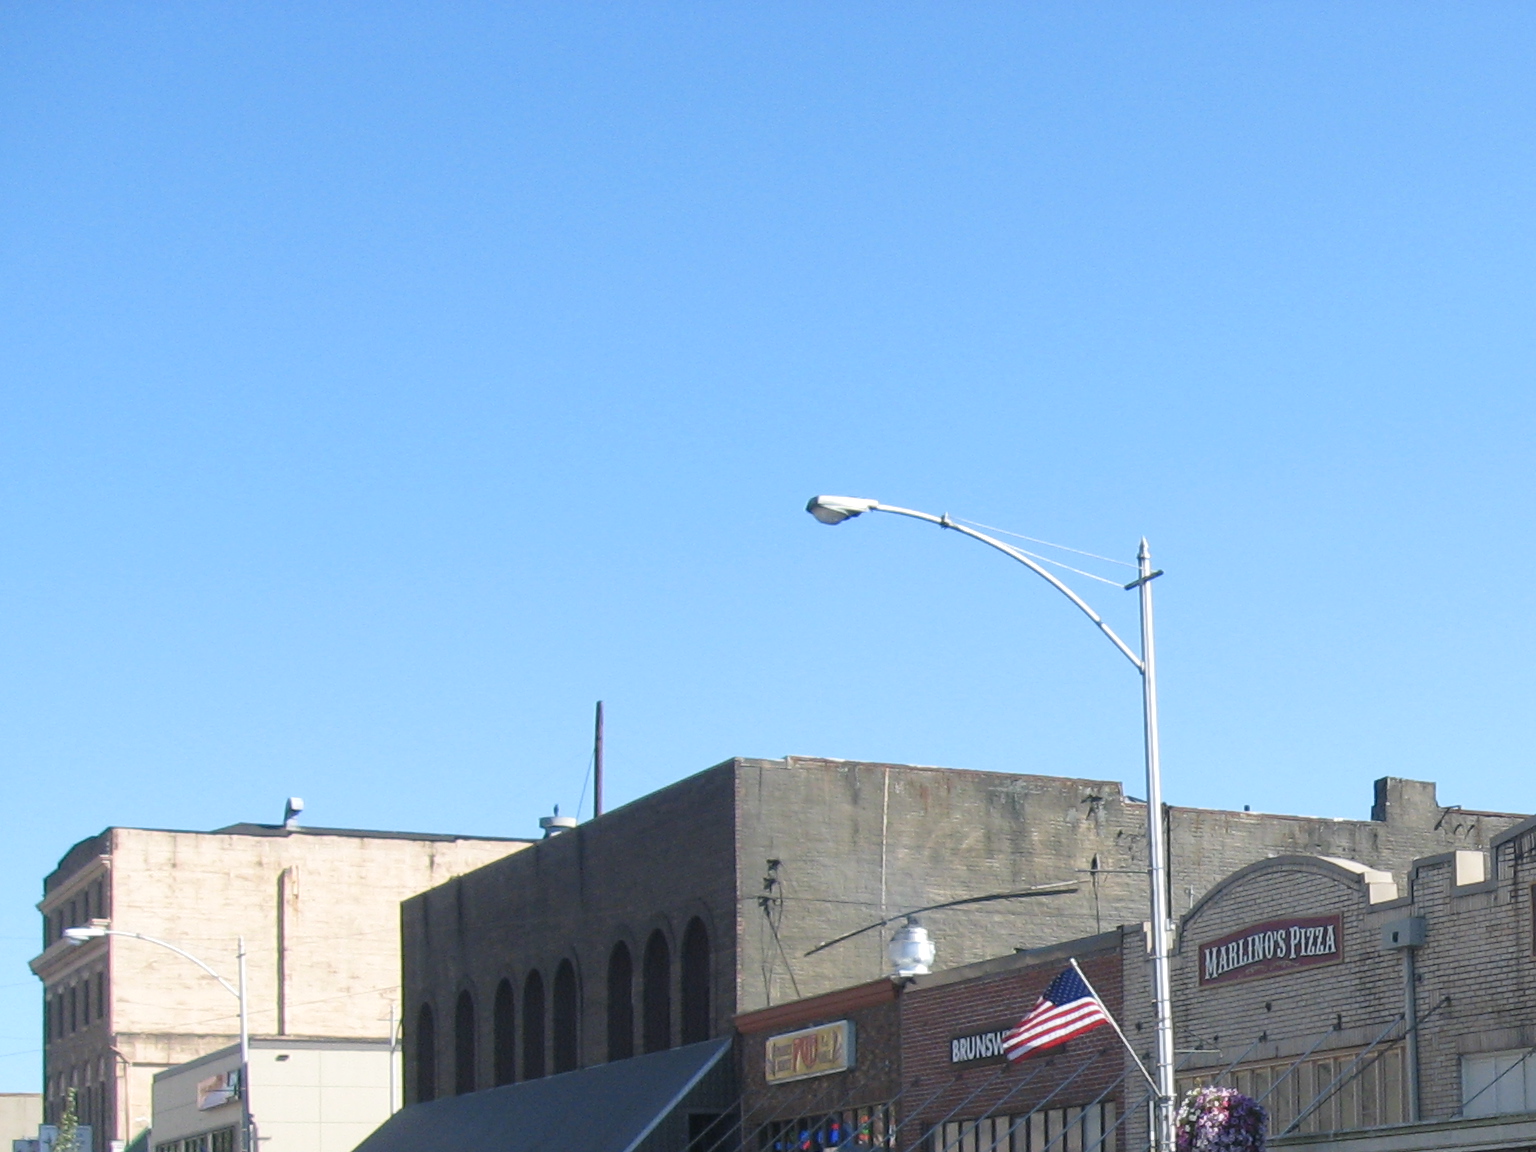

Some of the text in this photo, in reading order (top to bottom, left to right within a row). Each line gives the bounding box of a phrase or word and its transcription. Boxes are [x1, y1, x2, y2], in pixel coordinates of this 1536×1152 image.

[1204, 925, 1337, 979] MARLINO'S PIZZA
[952, 1029, 1009, 1062] BRUNSW
